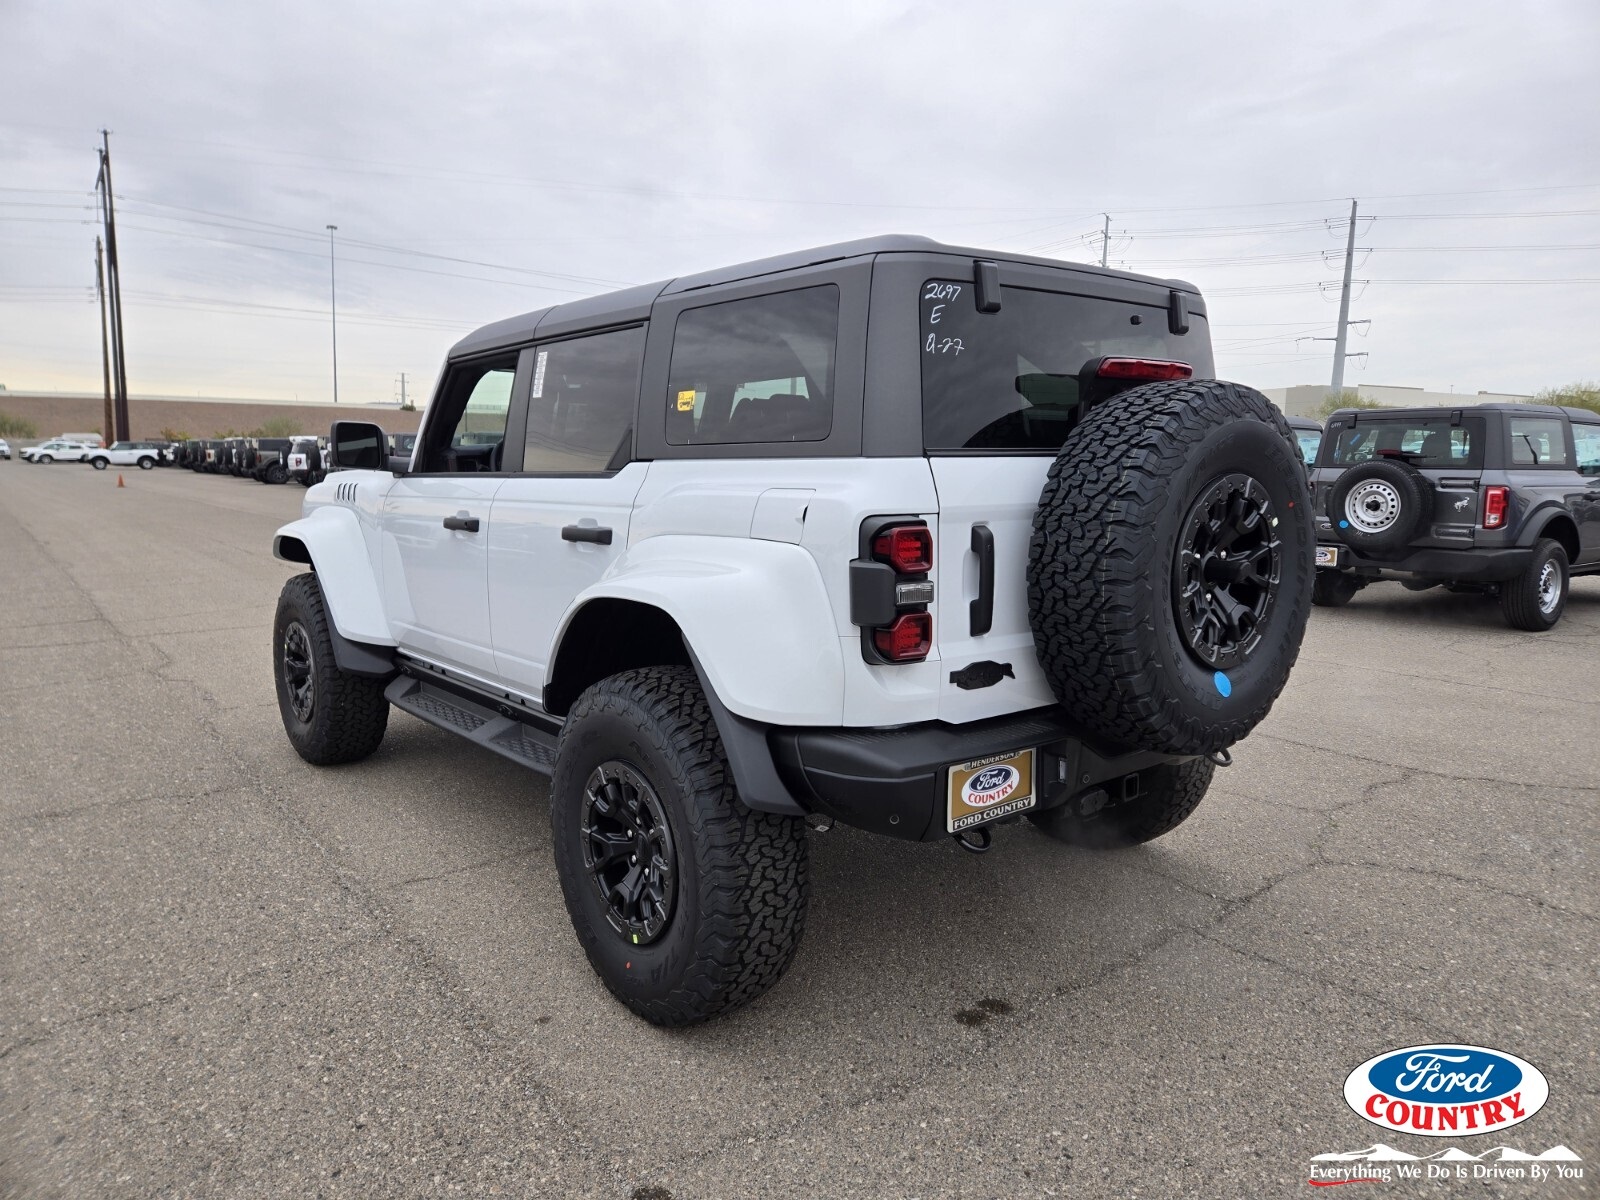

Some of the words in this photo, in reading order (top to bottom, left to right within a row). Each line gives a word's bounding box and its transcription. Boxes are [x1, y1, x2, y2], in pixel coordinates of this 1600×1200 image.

[924, 283, 961, 301] 2697
[930, 304, 946, 324] E
[976, 769, 1006, 790] Ford
[968, 781, 1014, 804] COUNTRY
[953, 814, 982, 830] FORD
[983, 798, 1031, 820] COUNTRY
